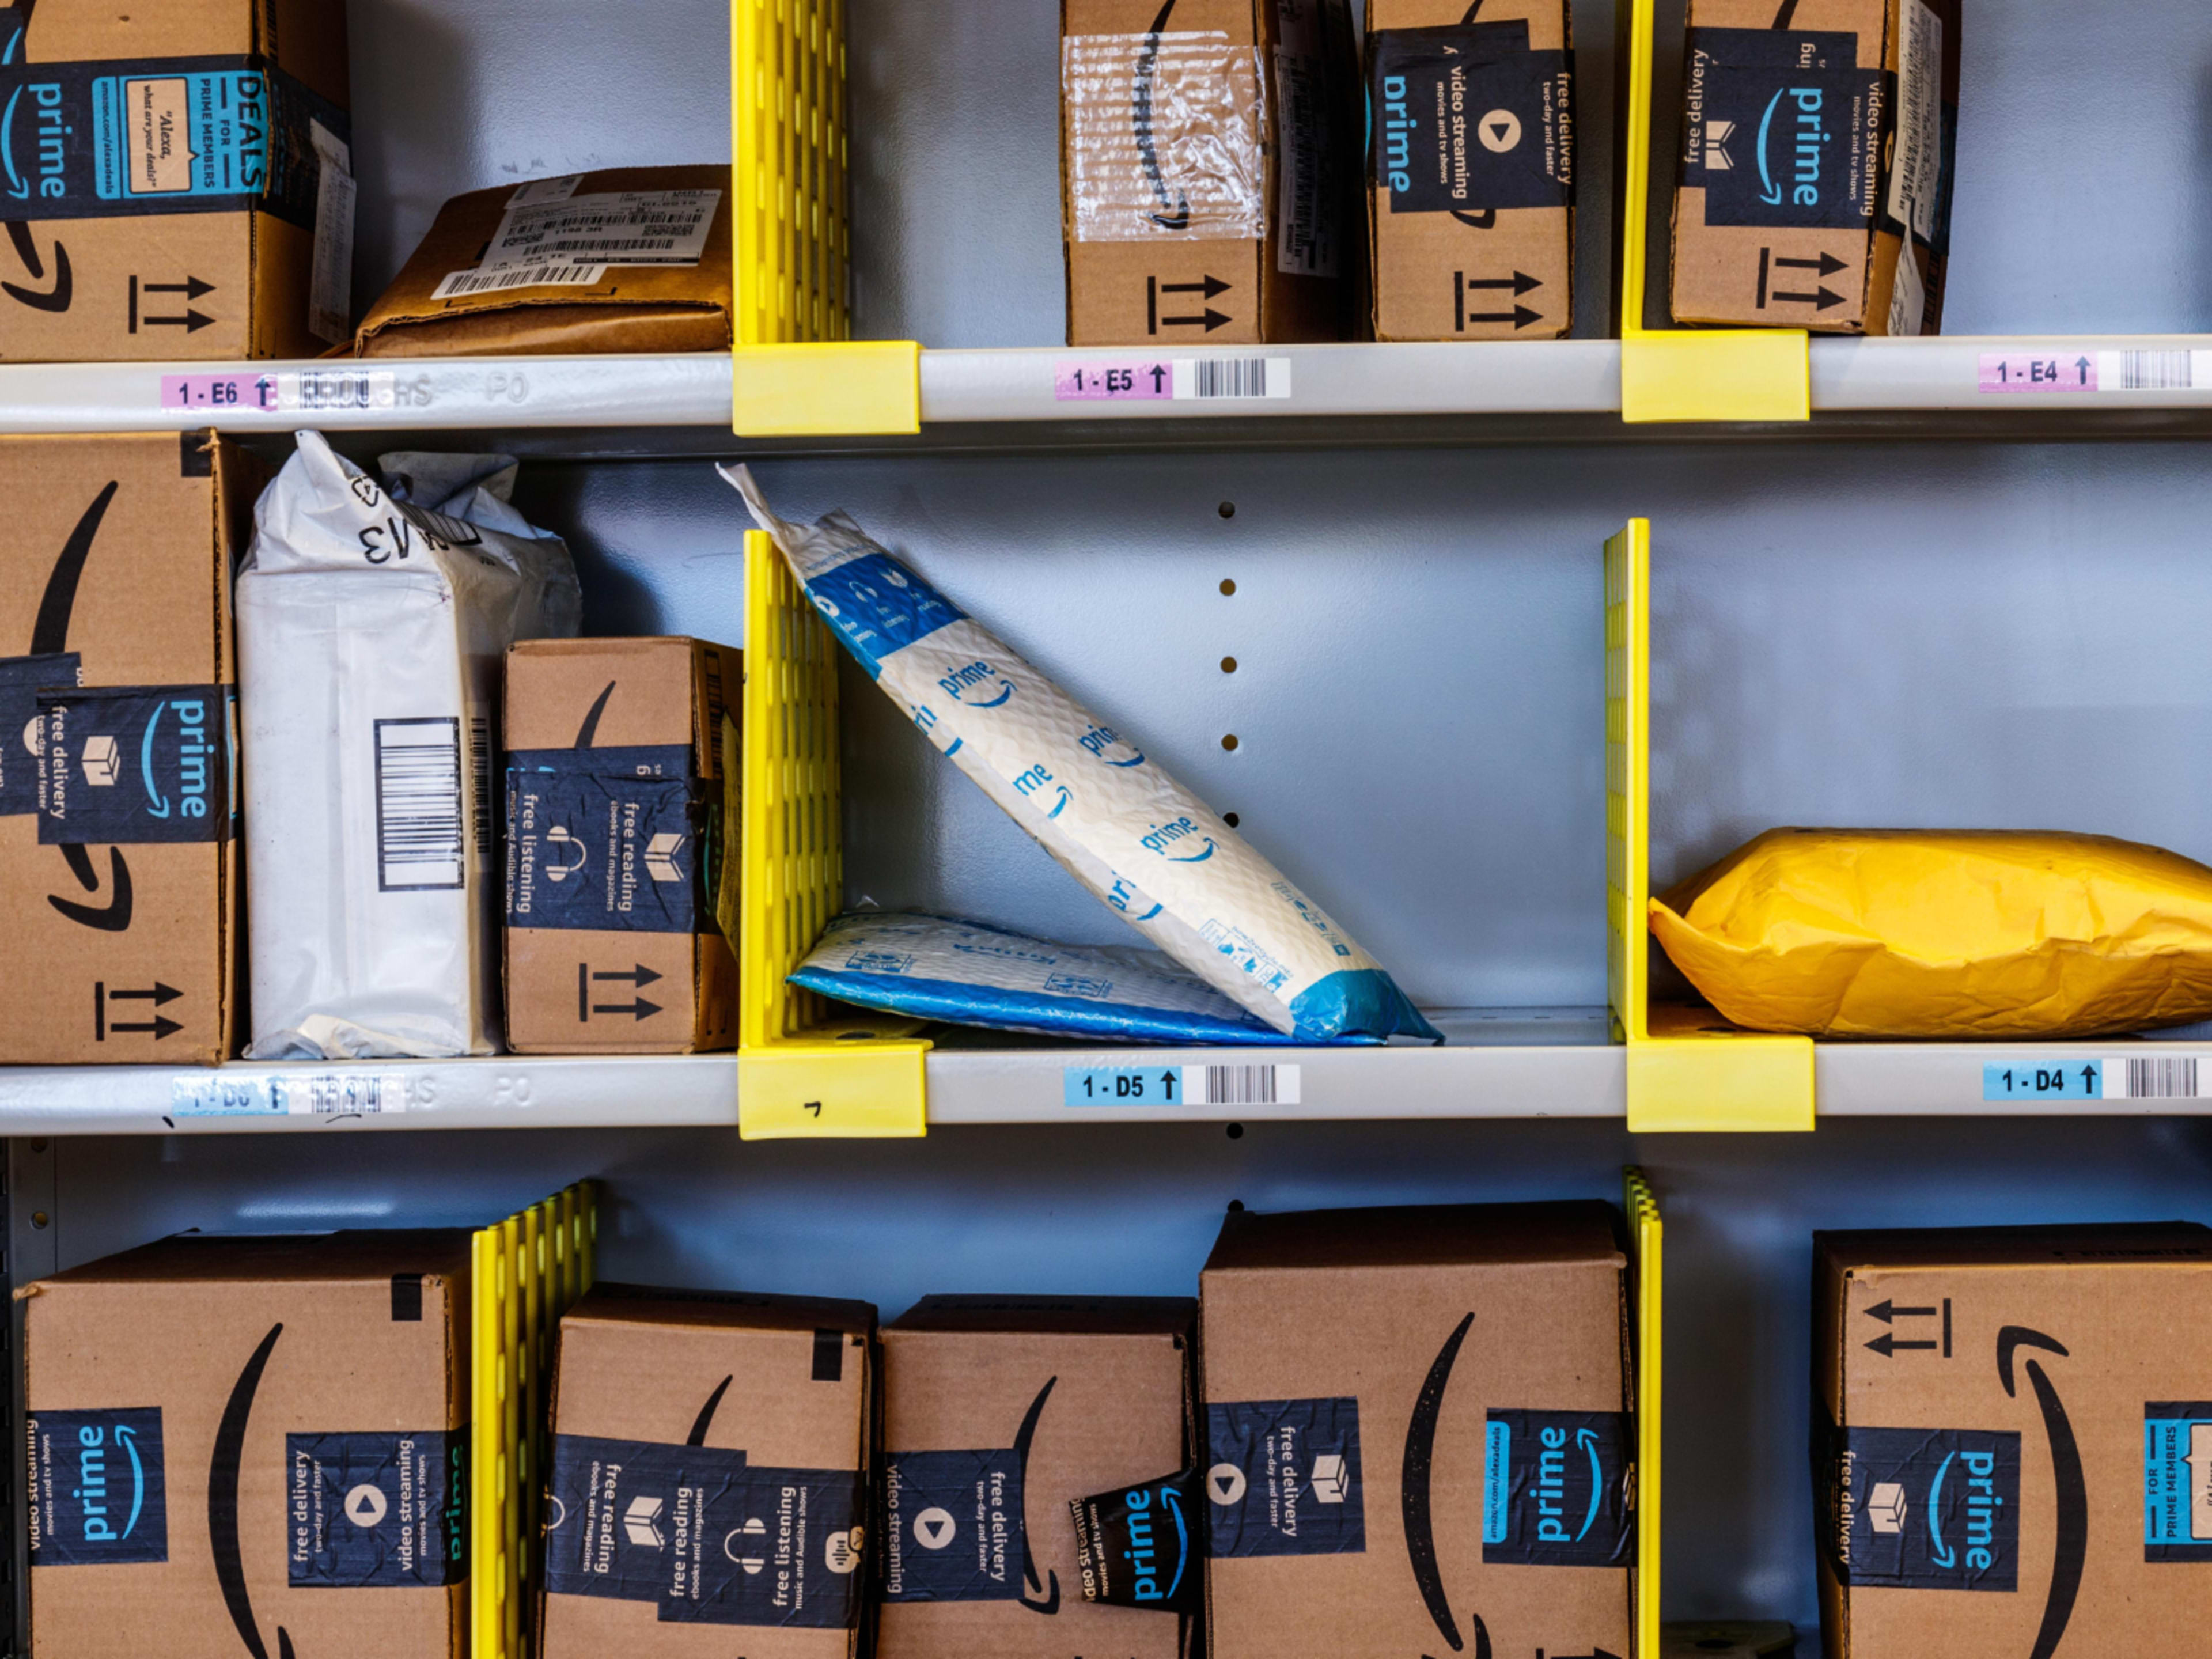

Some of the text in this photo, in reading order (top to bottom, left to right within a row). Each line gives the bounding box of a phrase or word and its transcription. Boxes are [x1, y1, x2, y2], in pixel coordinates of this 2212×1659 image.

[28, 82, 72, 198] prime
[101, 81, 115, 194] amazon.com/alexadeals
[143, 127, 153, 151] your
[144, 85, 154, 109] what
[201, 78, 215, 188] PRIME MEMBERS
[219, 119, 230, 146] FOR
[237, 76, 263, 187] DEALS
[1436, 81, 1448, 184] movies and tv shows
[1450, 66, 1467, 112] video
[1541, 81, 1554, 176] two-day and faster
[1557, 72, 1573, 185] free delivery
[1684, 48, 1709, 164] free delivery
[1851, 96, 1861, 132] movies
[1452, 115, 1470, 199] streaming
[1789, 88, 1831, 206] prime
[1849, 169, 1858, 200] shows
[1851, 155, 1858, 167] tv
[1860, 81, 1880, 216] video streaming
[179, 382, 188, 404] 1
[212, 382, 237, 404] E6
[1074, 369, 1082, 390] 1
[1107, 369, 1132, 391] E5
[1998, 361, 2006, 382] 1
[2031, 361, 2058, 382] E4
[938, 660, 995, 700] prime
[37, 715, 48, 809] two-day and faster
[50, 706, 69, 819] free delivery
[171, 700, 215, 817] prime
[507, 843, 517, 884] Audible
[508, 821, 517, 840] and
[516, 794, 539, 914] free listening
[606, 800, 618, 912] ebooks and magazines
[618, 802, 640, 912] free reading
[1139, 816, 1198, 855] prime
[1083, 1075, 1092, 1097] 1
[1116, 1075, 1143, 1097] D5
[2002, 1070, 2012, 1091] 1
[2036, 1070, 2063, 1091] D4
[26, 1419, 41, 1551] video streaming
[41, 1434, 55, 1536] movies and tv shows
[73, 1426, 118, 1541] prime
[293, 1450, 310, 1563] free delivery
[313, 1460, 324, 1554] two-day and faster
[396, 1439, 415, 1571] video streaming
[417, 1454, 427, 1556] movies and tv shows
[583, 1460, 601, 1573] ebooks and magazines
[594, 1464, 622, 1573] free reading
[887, 1464, 905, 1594] video streaming
[976, 1481, 988, 1571] two-day and faster
[991, 1471, 1007, 1582] free delivery
[1267, 1435, 1279, 1528] two-day and faster
[1281, 1426, 1298, 1536] free delivery
[1491, 1427, 1501, 1540] amazon.com/alexadeals
[1529, 1426, 1571, 1542] prime
[1838, 1449, 1857, 1565] free delivery
[1960, 1451, 2003, 1569] prime
[2149, 1468, 2158, 1495] FOR
[2165, 1426, 2177, 1538] PRIME MEMBERS
[670, 1487, 692, 1597] free reading
[690, 1488, 704, 1600] ebooks and magazines
[772, 1486, 796, 1607] free listening
[794, 1486, 807, 1609] music and Audible shows
[1093, 1531, 1101, 1542] tv
[1093, 1543, 1105, 1561] and
[1098, 1562, 1109, 1597] movies
[1124, 1490, 1163, 1601] prime
